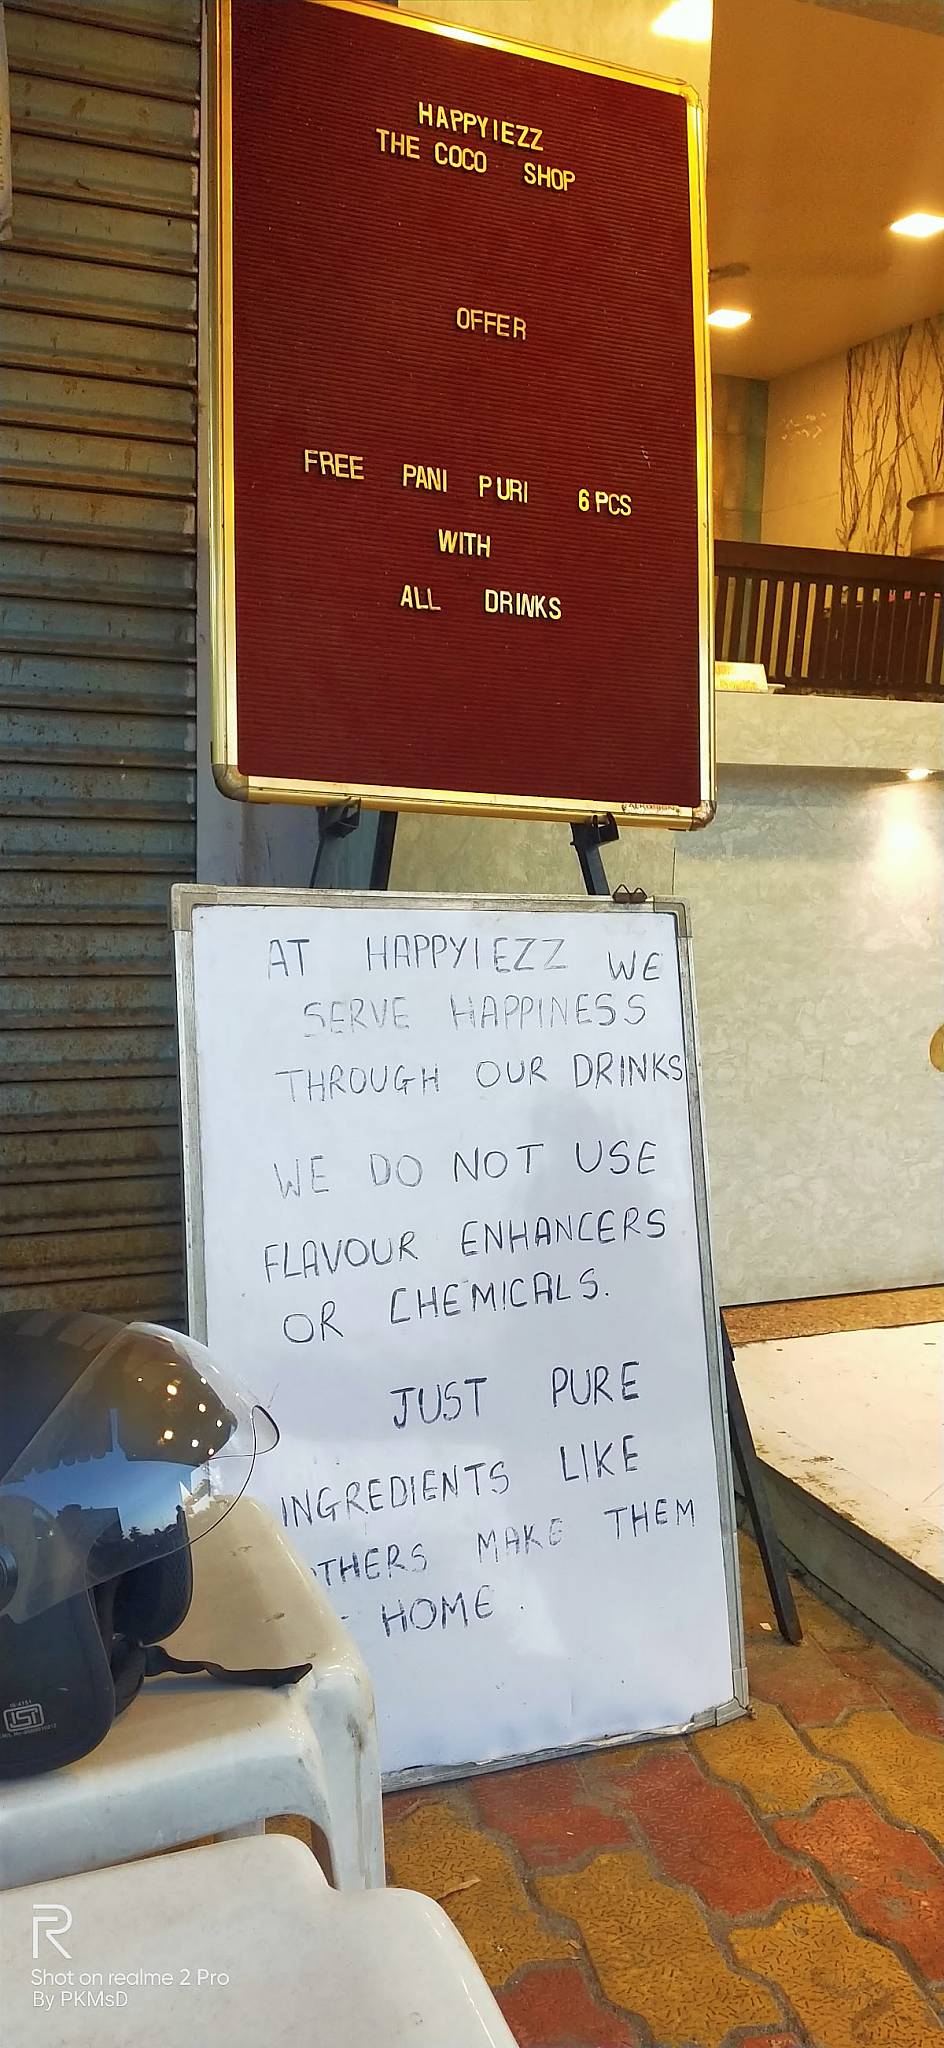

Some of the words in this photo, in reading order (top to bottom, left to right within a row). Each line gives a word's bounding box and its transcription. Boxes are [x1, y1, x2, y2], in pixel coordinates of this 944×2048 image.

[418, 101, 544, 151] HAPPYIEZZ
[376, 128, 420, 160] THE
[434, 142, 488, 173] COCO
[523, 161, 576, 191] SHOP
[456, 307, 527, 340] OFFER
[304, 449, 365, 480] FREE
[402, 464, 447, 493] PANI
[479, 475, 528, 503] PURI
[438, 528, 491, 558] WITH
[400, 585, 441, 611] ALL
[485, 589, 562, 620] DRINKS
[268, 938, 309, 979] AT
[367, 935, 567, 973] HAPPYIEZZ
[608, 951, 662, 981] WE
[302, 996, 409, 1037] SERVE
[450, 994, 647, 1030] HAPPINESS
[275, 1064, 439, 1102] THROUGH
[476, 1055, 547, 1089] OUR
[573, 1051, 684, 1088] DRINKS
[273, 1154, 330, 1199] WE
[369, 1152, 424, 1188] DO
[454, 1143, 544, 1184] NOT
[575, 1140, 657, 1175] USE
[264, 1231, 418, 1282] FLAVOUR
[461, 1207, 666, 1257] ENHANCERS
[283, 1300, 343, 1344] OR
[390, 1268, 610, 1325] CHEMICALS.
[390, 1377, 487, 1429] JUST
[552, 1361, 639, 1408] PURE
[281, 1461, 510, 1527] INGREDIENTS
[560, 1435, 639, 1483] LIKE
[311, 1543, 427, 1587] THERS
[477, 1518, 564, 1564] MAKE
[604, 1499, 696, 1540] THEM
